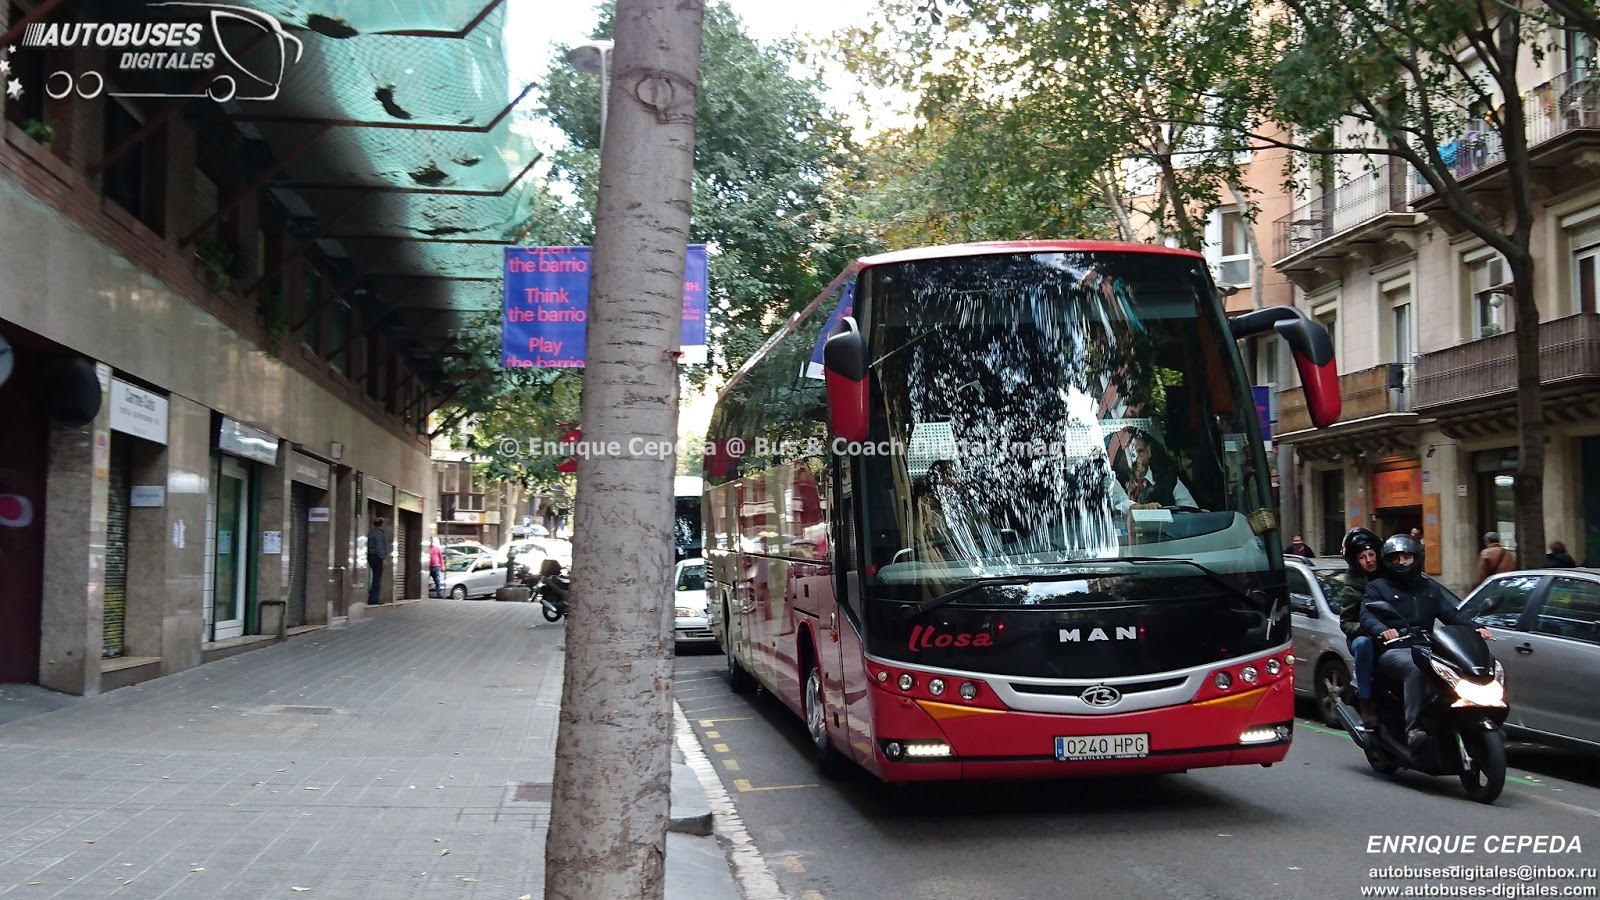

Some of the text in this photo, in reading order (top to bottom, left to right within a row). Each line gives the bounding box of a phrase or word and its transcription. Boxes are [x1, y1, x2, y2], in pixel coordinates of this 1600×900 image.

[509, 258, 588, 273] the barrio
[525, 287, 569, 304] Think
[507, 307, 587, 322] the barrio
[528, 338, 563, 356] Play
[505, 356, 585, 367] the barrio
[1059, 626, 1137, 642] MAN
[1067, 737, 1144, 754] 0240 HPG
